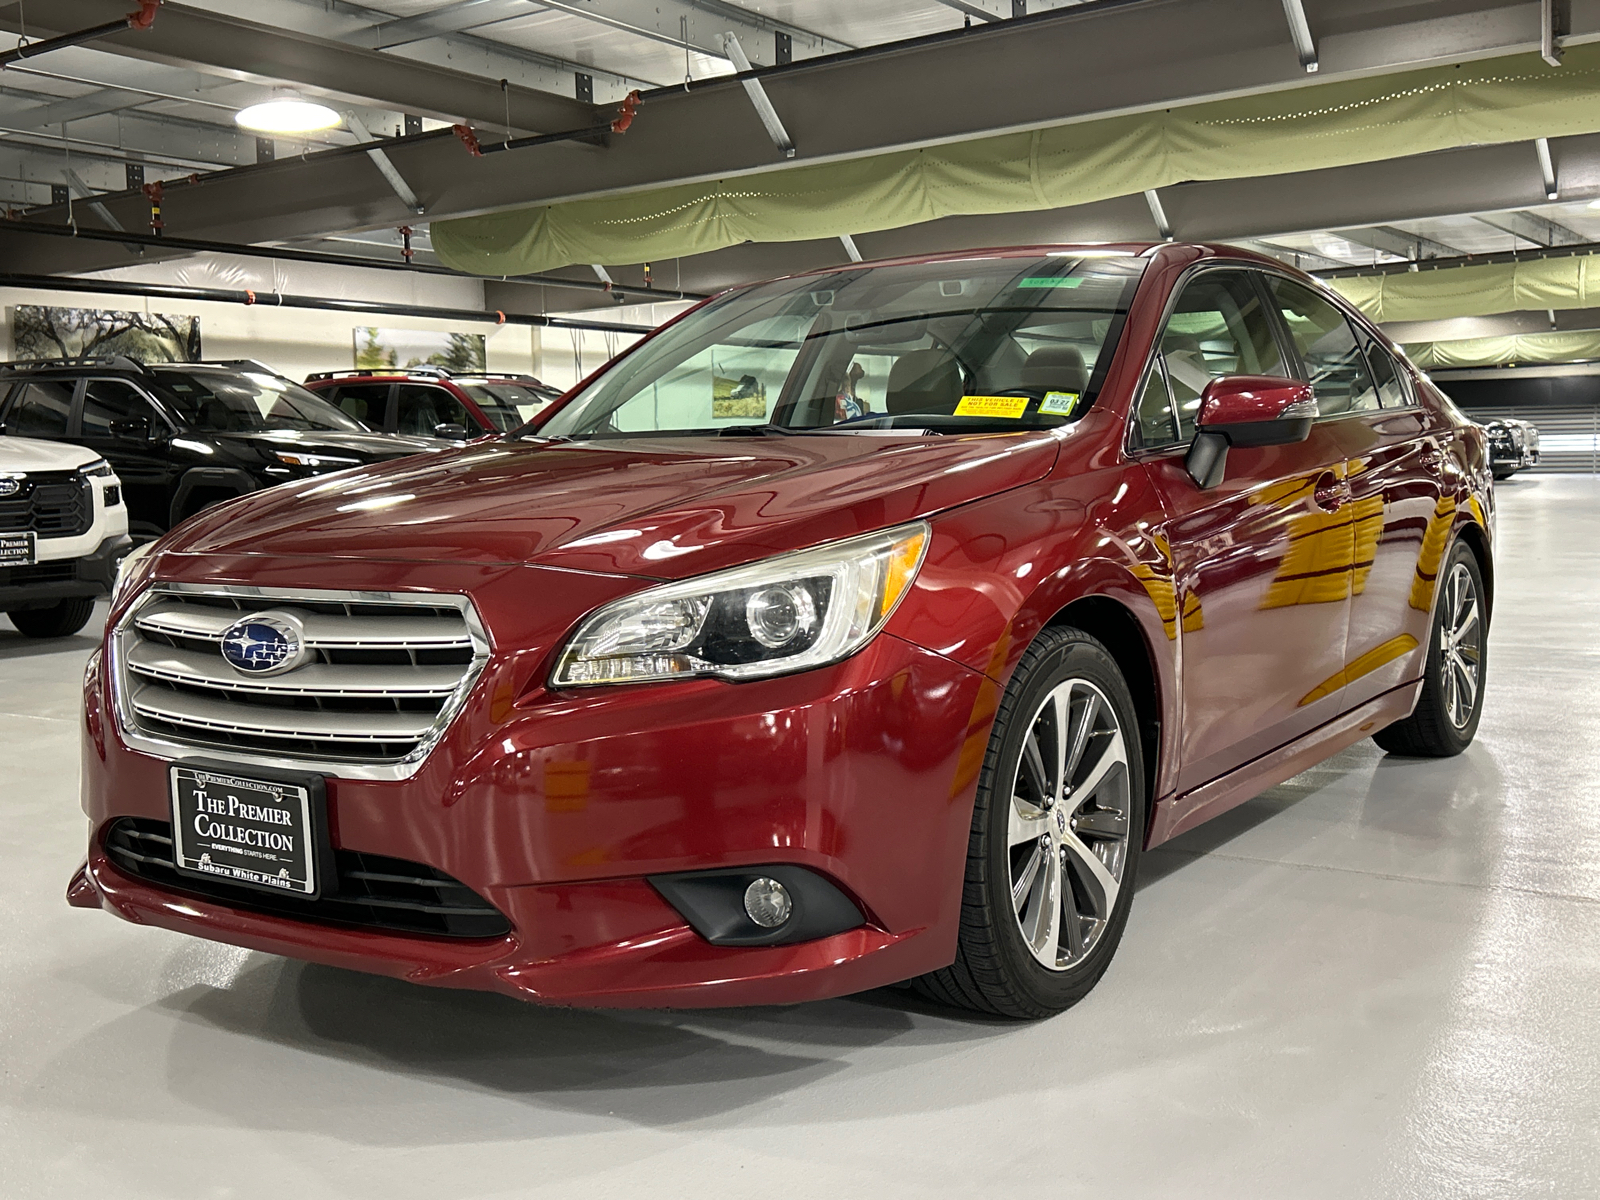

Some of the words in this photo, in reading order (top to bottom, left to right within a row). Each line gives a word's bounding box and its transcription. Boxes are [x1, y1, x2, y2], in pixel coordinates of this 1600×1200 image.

[193, 790, 226, 815] THE
[227, 795, 293, 827] PREMIER
[194, 814, 294, 852] COLLECTION
[211, 843, 244, 855] EVERYTHING
[243, 849, 263, 859] STARTS
[198, 862, 230, 875] Subaru
[232, 867, 260, 881] White
[262, 875, 291, 888] Plains
